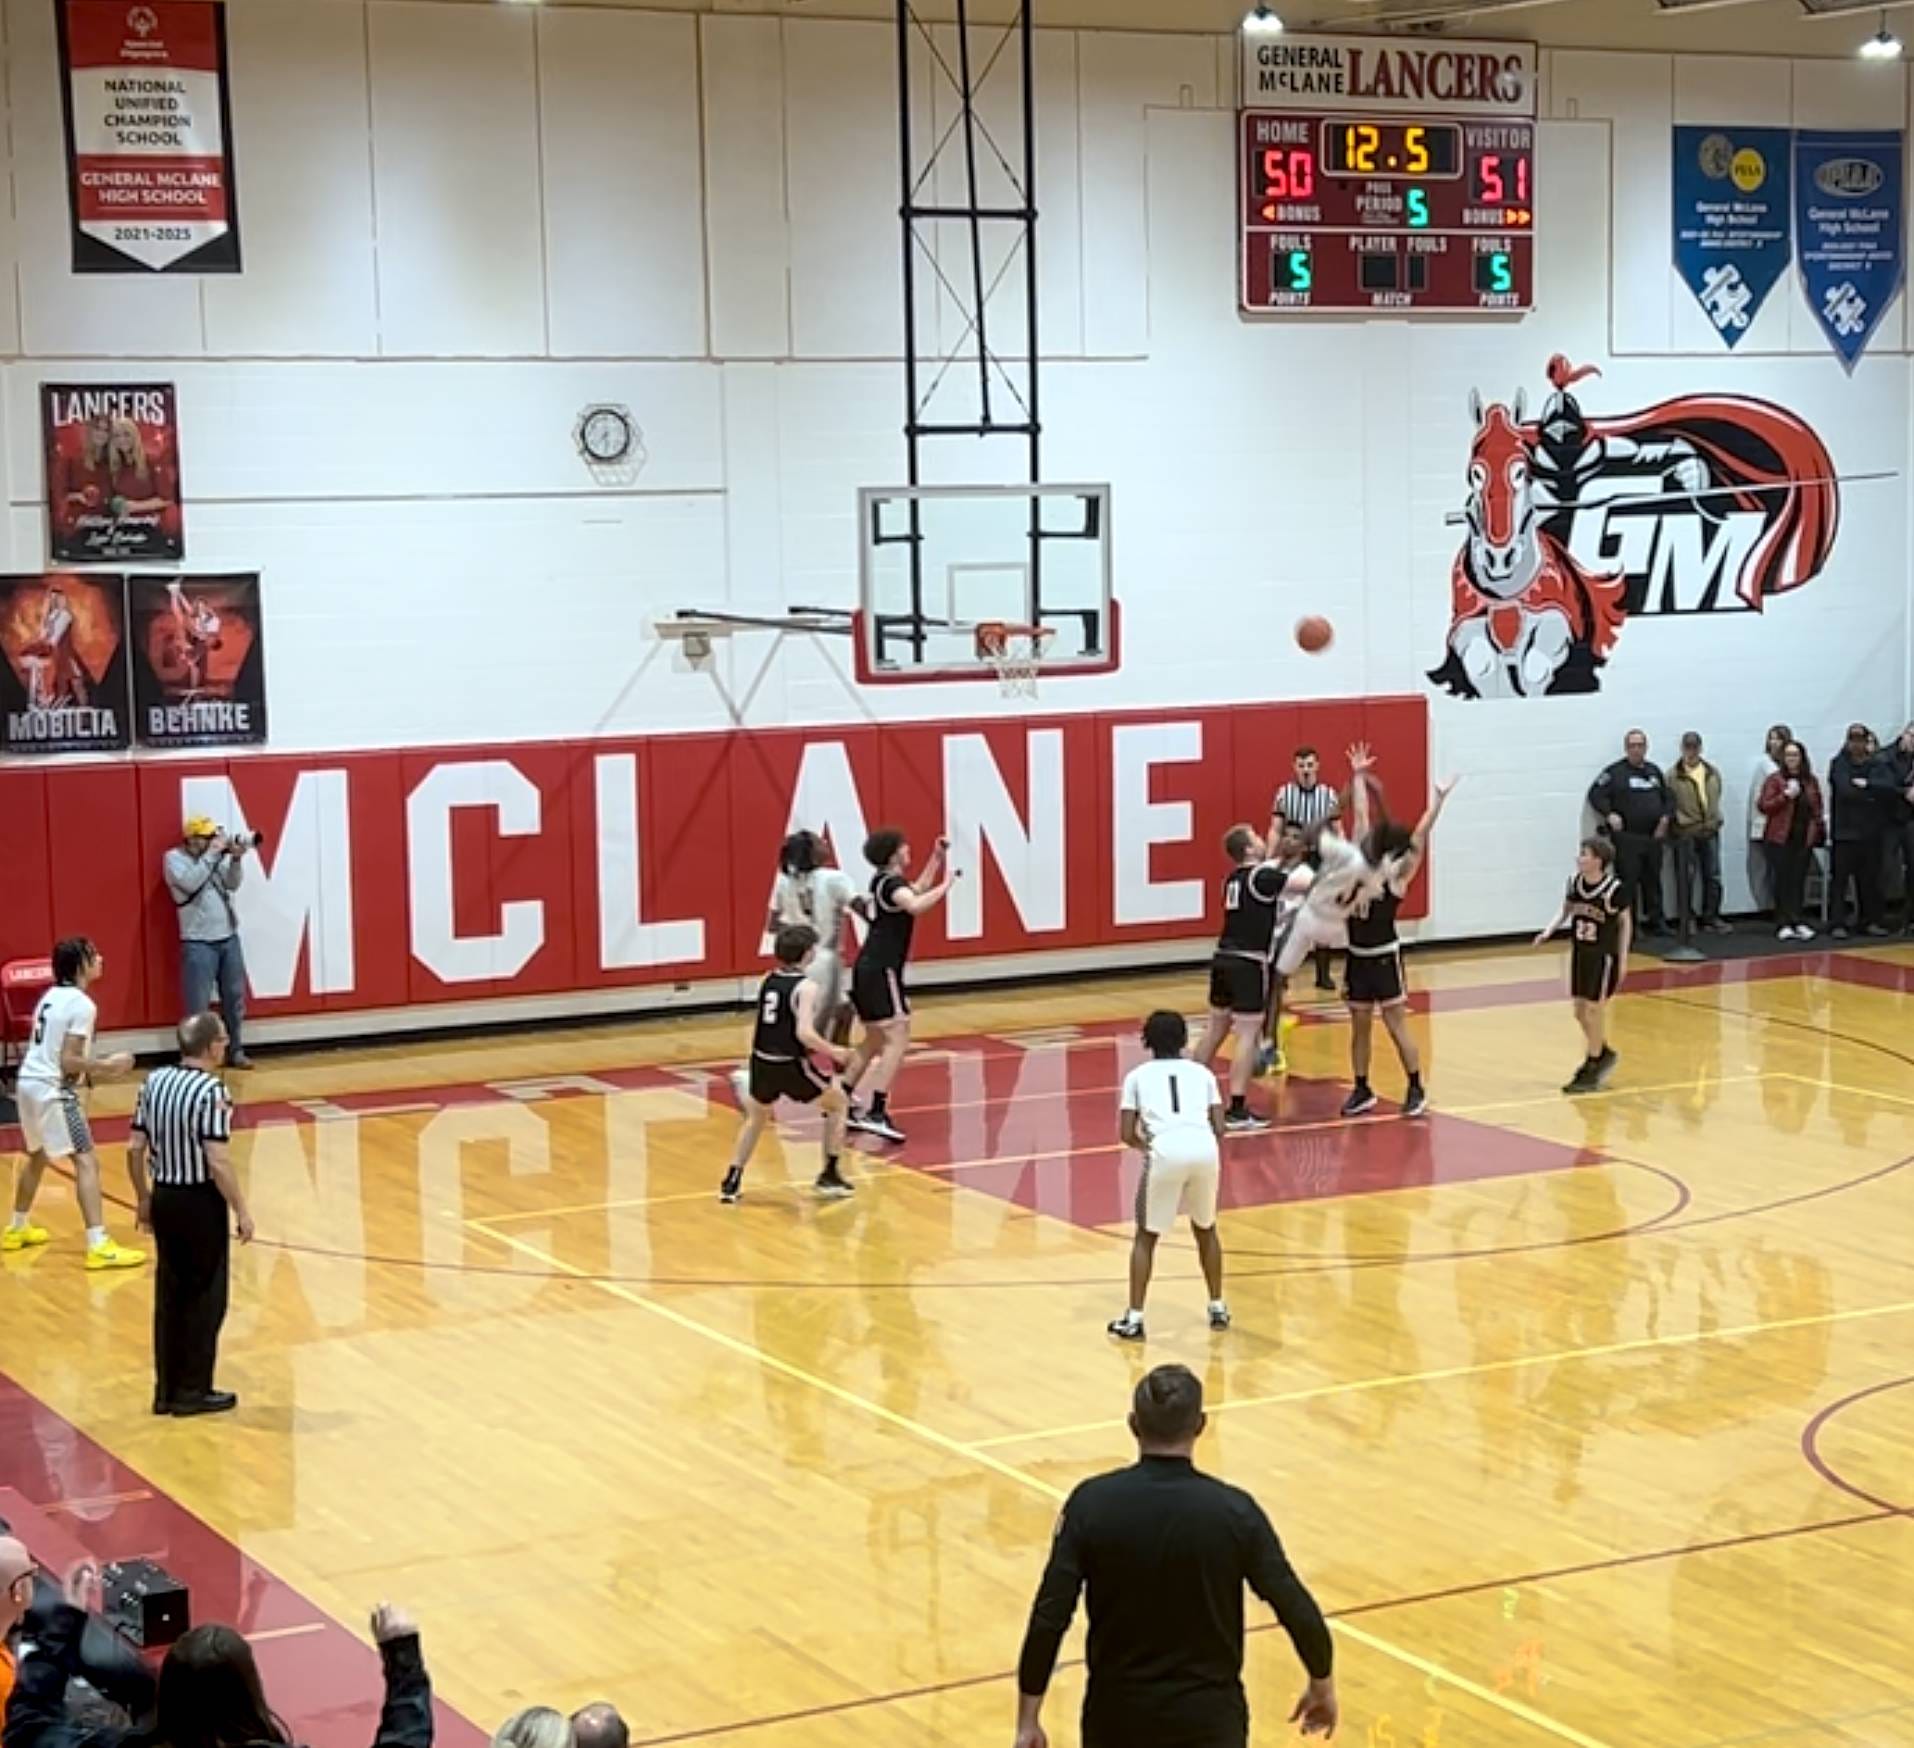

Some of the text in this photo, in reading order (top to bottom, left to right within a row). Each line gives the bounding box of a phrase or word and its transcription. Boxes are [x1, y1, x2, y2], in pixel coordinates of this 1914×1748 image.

[1257, 45, 1344, 68] GENERAL
[104, 79, 186, 93] NATIONAL
[1259, 71, 1345, 93] McLANE
[1346, 48, 1522, 103] LANCERS
[115, 98, 179, 110] UNIFIED
[104, 114, 192, 127] CHAMPION
[1256, 119, 1309, 143] HOME
[117, 131, 183, 145] SCHOOL
[1345, 125, 1428, 172] 12.5
[1466, 126, 1531, 148] VISITOR
[81, 172, 220, 188] GENERAL MCLANE
[1264, 150, 1313, 197] 50
[1480, 155, 1527, 202] 51
[99, 189, 208, 204] HIGH SCHOOL
[1356, 194, 1403, 212] PERIOD
[1407, 188, 1429, 227] 5
[1276, 204, 1320, 221] BONUS
[1462, 207, 1505, 225] BONUS
[1270, 233, 1311, 250] FOULS
[1349, 235, 1447, 252] PLAYER FOULS
[1473, 236, 1512, 253] FOULS
[1289, 251, 1312, 290] 5
[1490, 253, 1512, 292] 5
[52, 391, 165, 428] LANCERS
[1567, 474, 1767, 613] GM
[149, 703, 251, 735] BEHNKE
[762, 991, 778, 1025] 2
[35, 1002, 53, 1046] 5
[1168, 1074, 1181, 1114] 1
